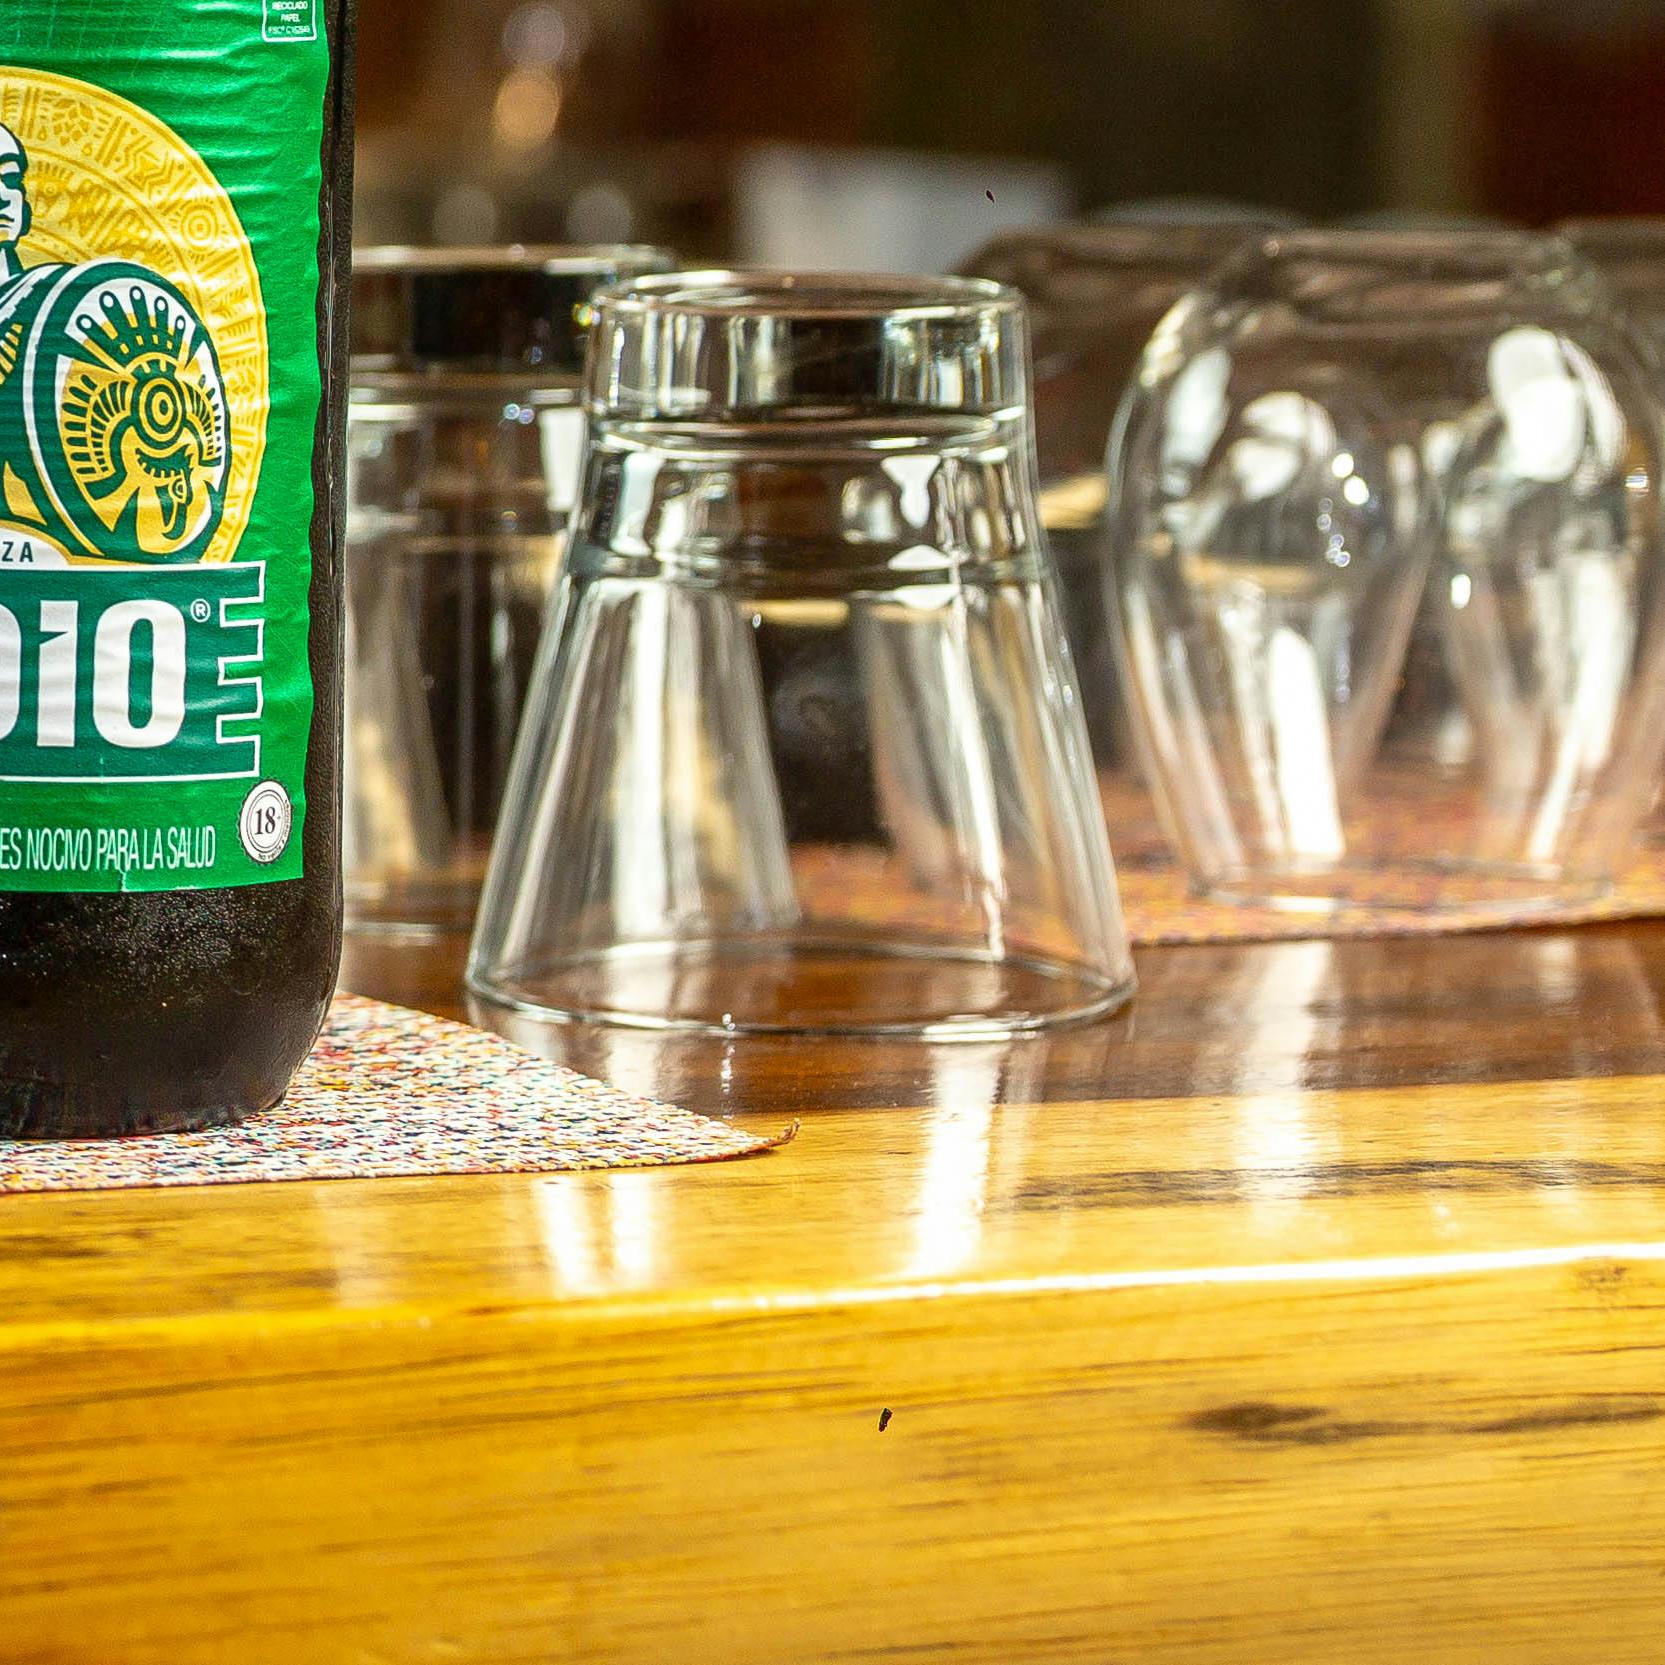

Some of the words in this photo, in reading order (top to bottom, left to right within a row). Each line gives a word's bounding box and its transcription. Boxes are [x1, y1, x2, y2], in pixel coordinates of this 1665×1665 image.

[0, 826, 23, 870] ES
[26, 827, 93, 871] NOCIVO
[96, 827, 141, 871] PARA
[143, 827, 164, 870] LA
[167, 825, 216, 870] SALUD
